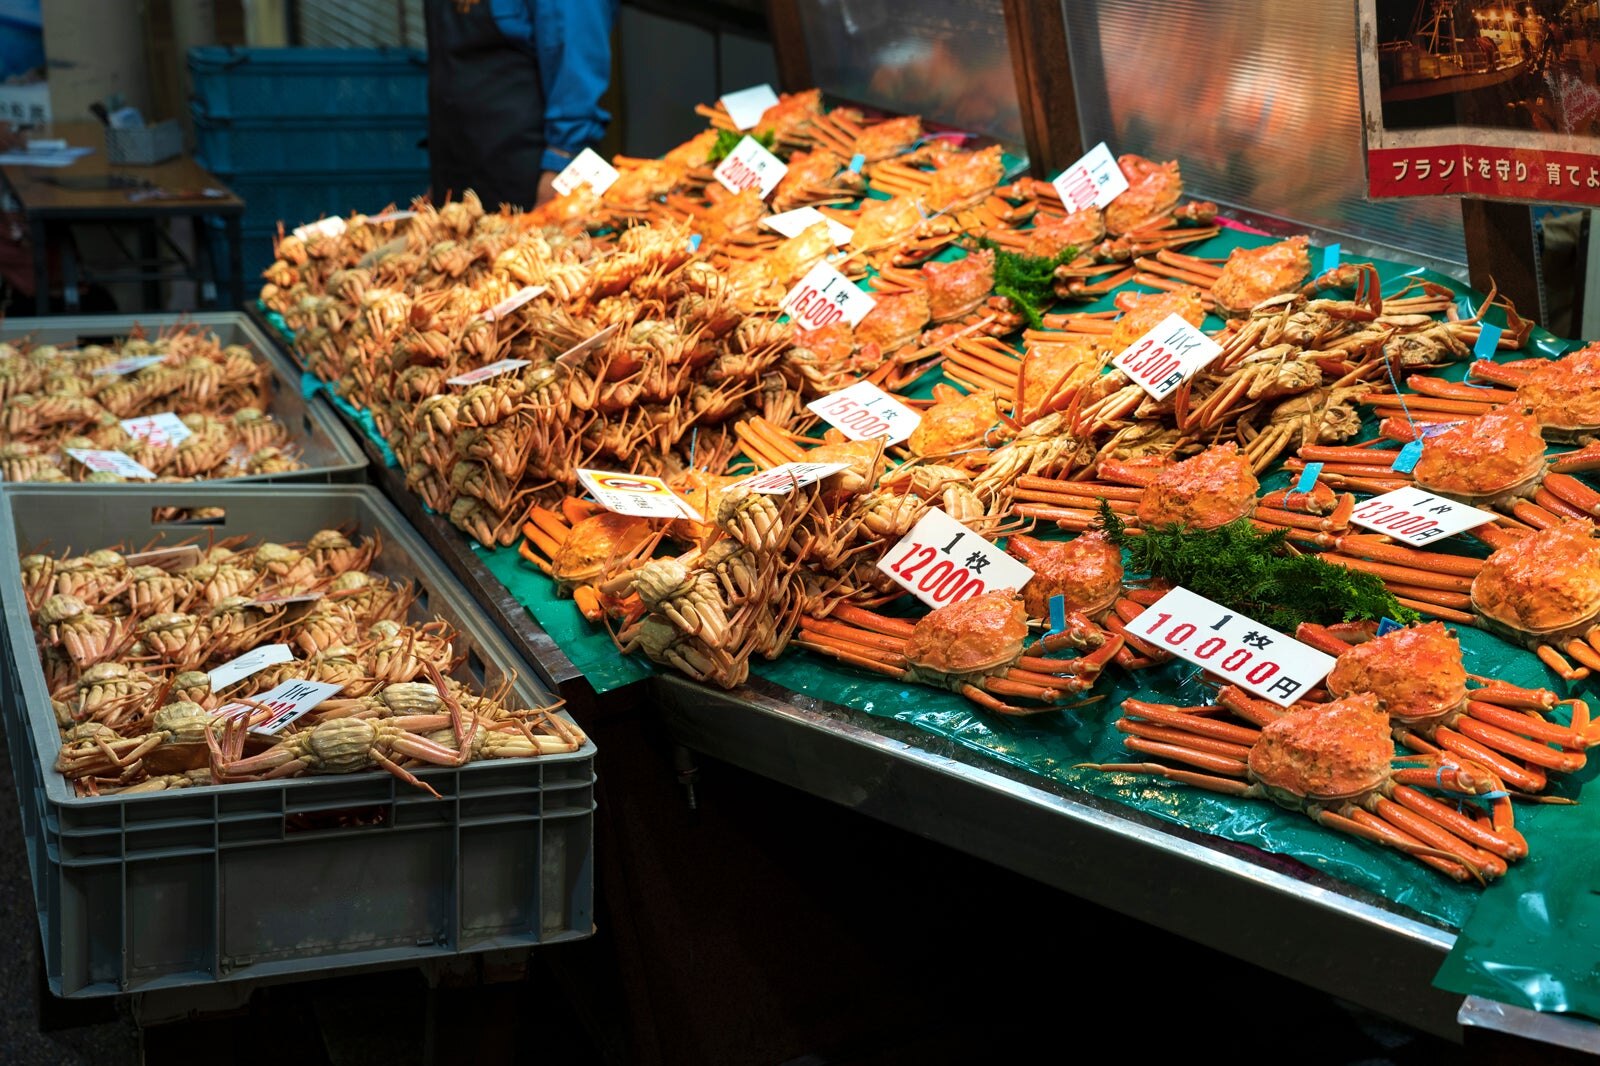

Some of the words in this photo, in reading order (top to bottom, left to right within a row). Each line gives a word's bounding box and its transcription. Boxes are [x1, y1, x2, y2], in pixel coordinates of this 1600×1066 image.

[1061, 166, 1101, 211] 17000
[1392, 156, 1528, 182] ブランドを守り
[1546, 162, 1600, 188] 育てよ
[822, 396, 894, 439] 15000
[891, 543, 987, 603] 12000
[1146, 612, 1303, 700] 10.000円
